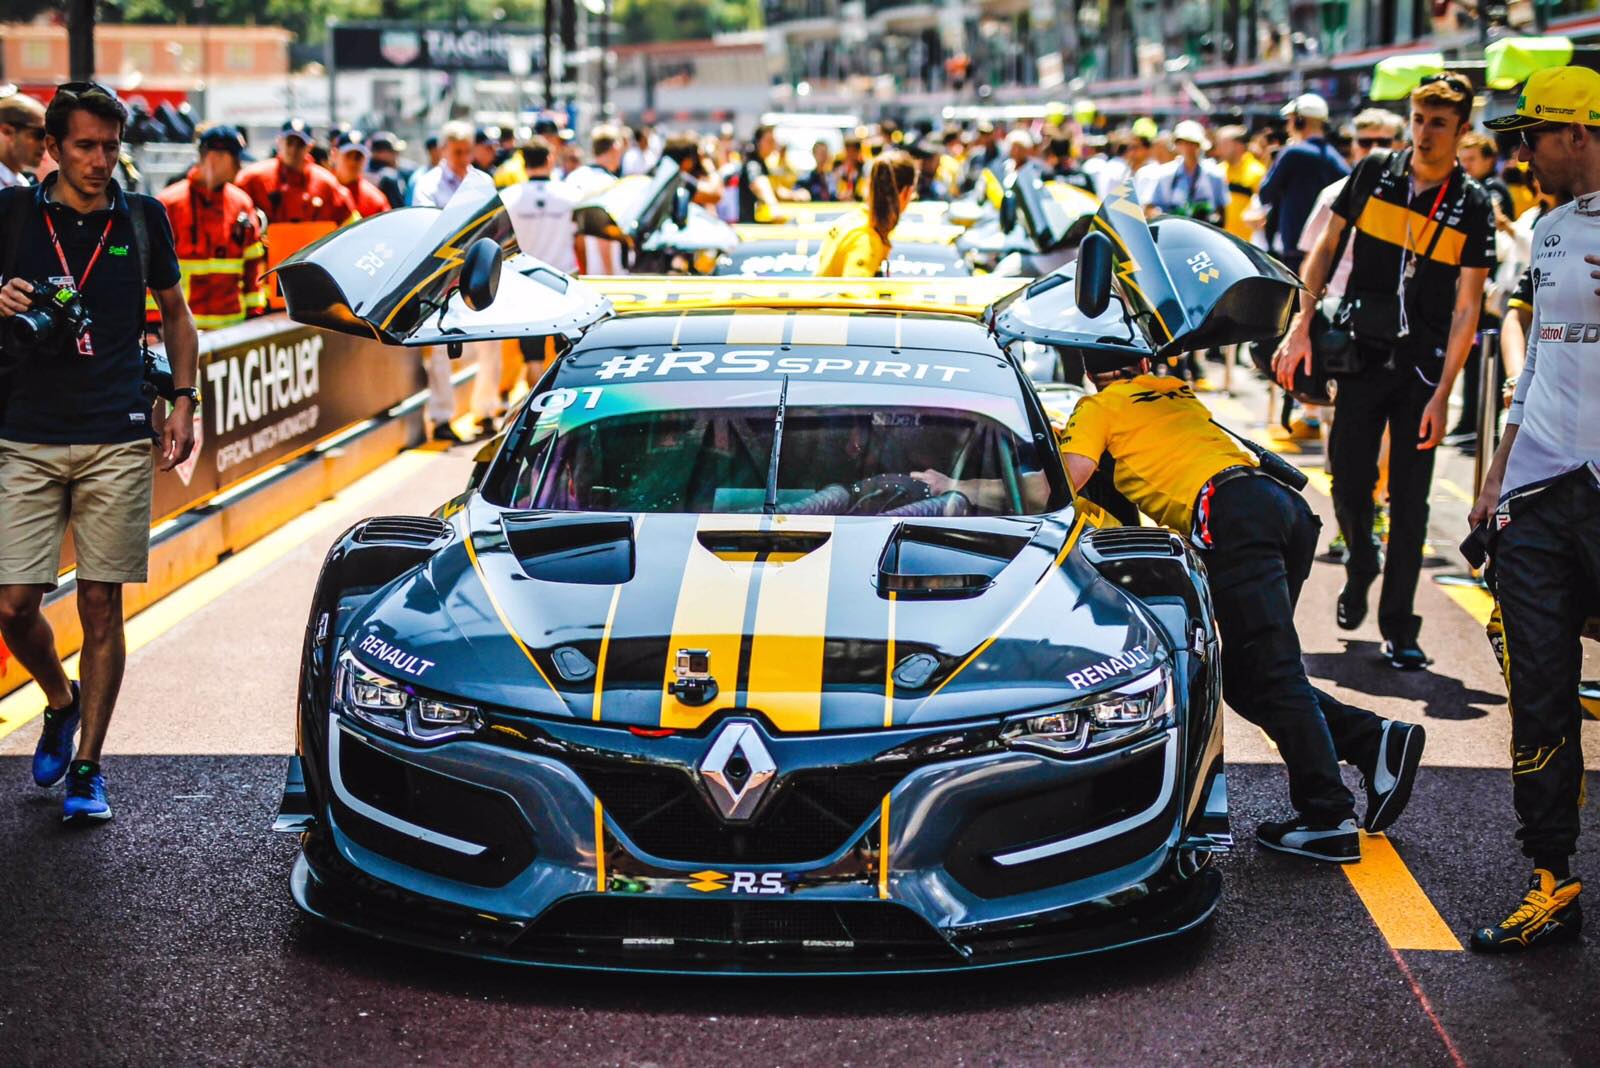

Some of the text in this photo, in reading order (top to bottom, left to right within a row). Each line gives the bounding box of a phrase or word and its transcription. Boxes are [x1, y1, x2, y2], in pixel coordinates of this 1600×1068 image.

[871, 411, 921, 426] Sabet
[359, 634, 436, 676] RENAULT
[1066, 645, 1150, 690] RENAULT
[731, 871, 786, 894] R.S.
